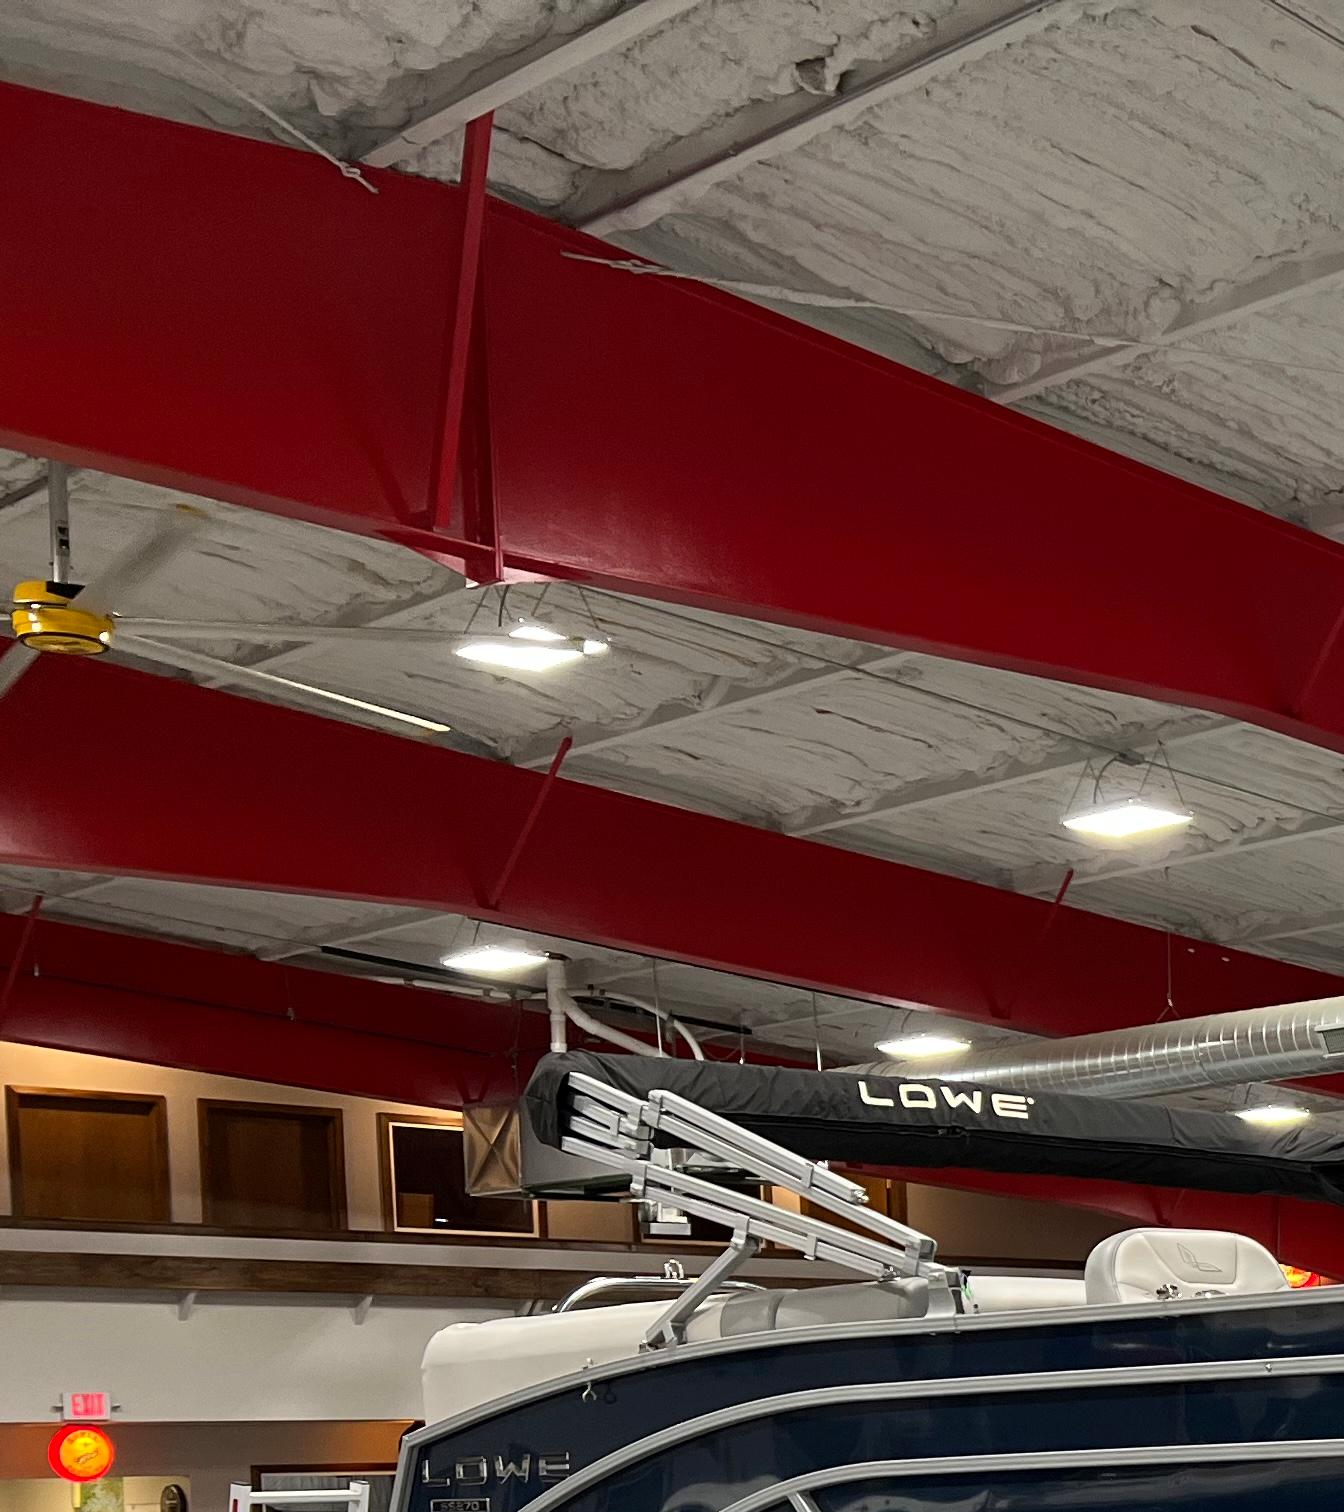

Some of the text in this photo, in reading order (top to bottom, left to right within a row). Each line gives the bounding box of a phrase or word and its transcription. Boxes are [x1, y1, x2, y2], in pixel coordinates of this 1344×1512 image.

[857, 1080, 1030, 1120] LOWE
[71, 1392, 105, 1416] EXIT
[421, 1451, 570, 1488] LOWE
